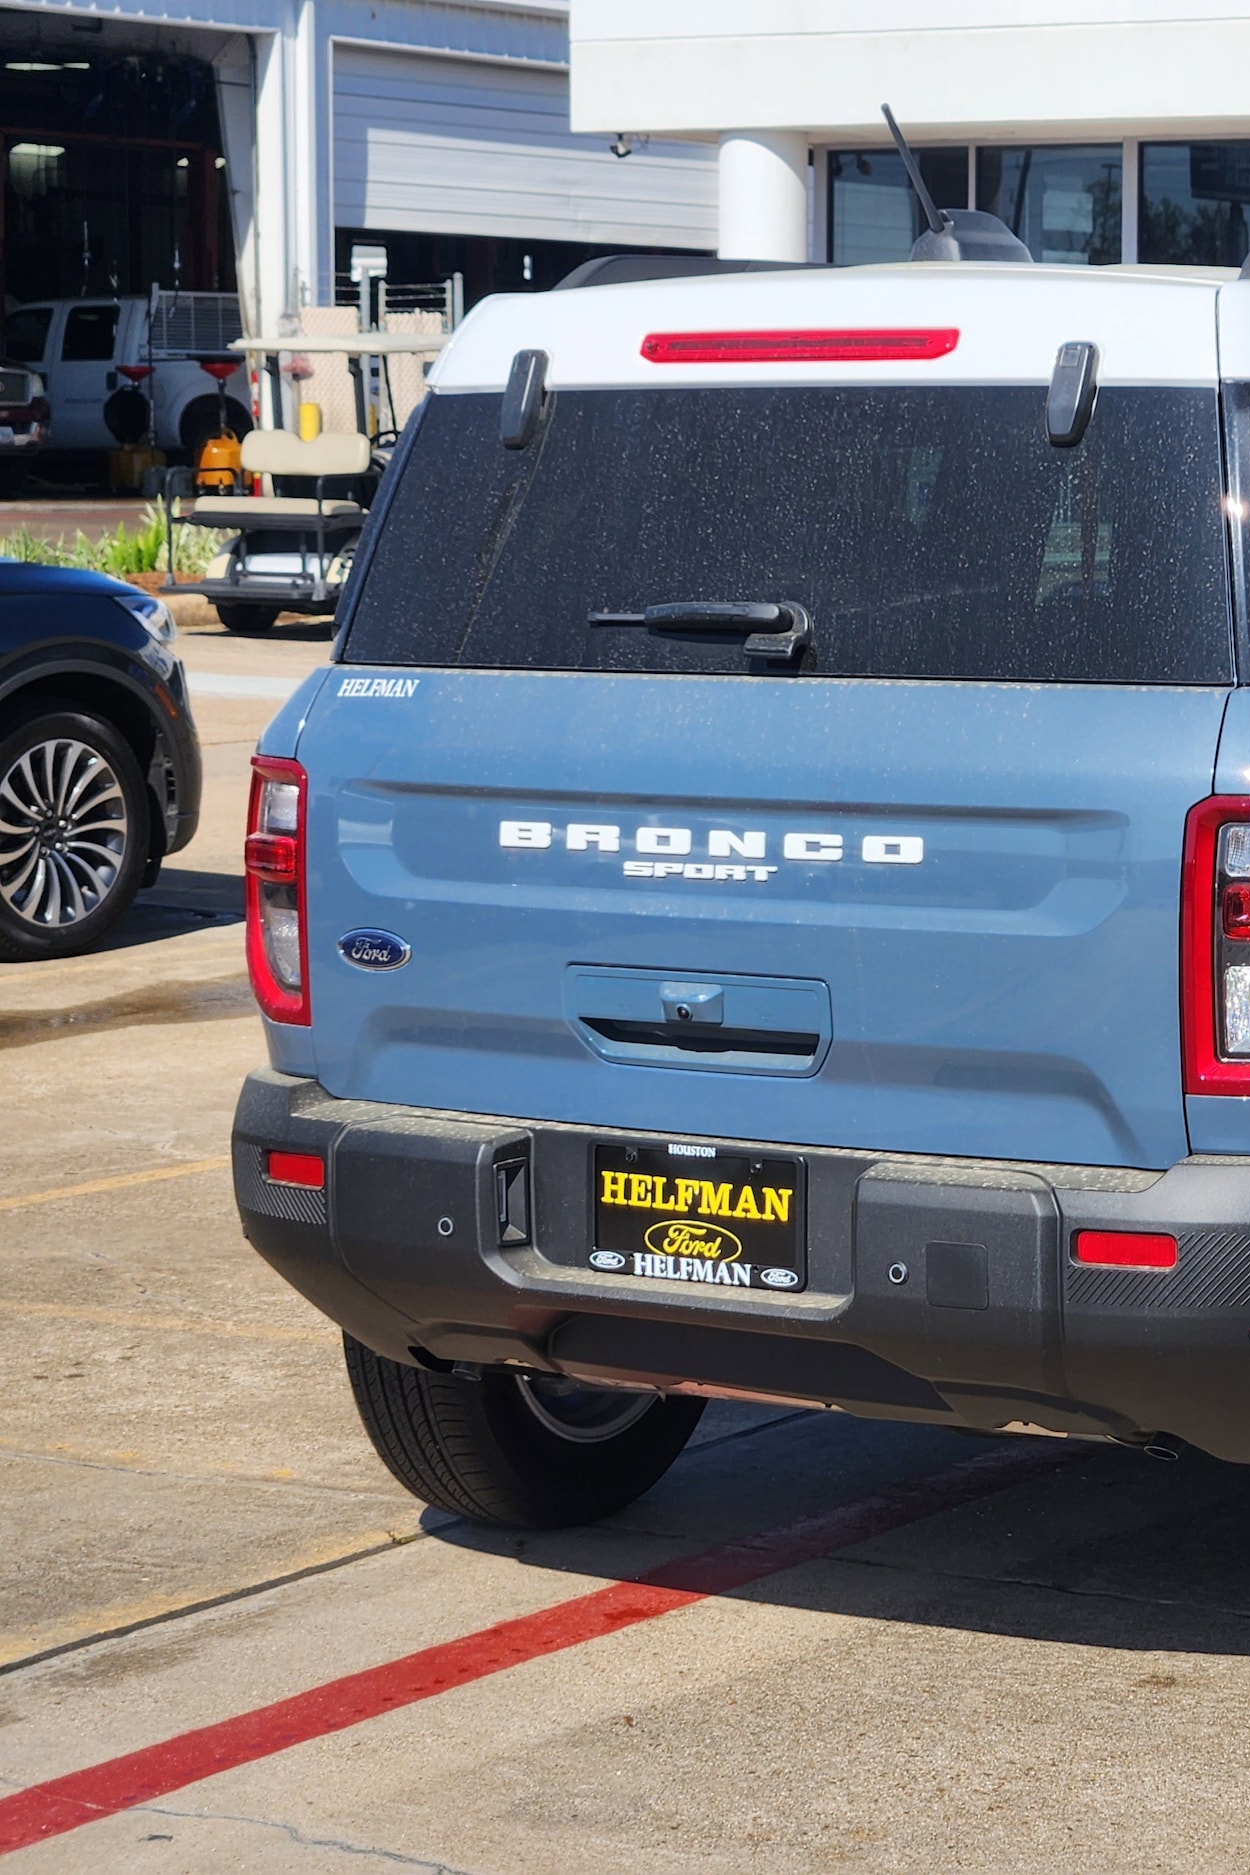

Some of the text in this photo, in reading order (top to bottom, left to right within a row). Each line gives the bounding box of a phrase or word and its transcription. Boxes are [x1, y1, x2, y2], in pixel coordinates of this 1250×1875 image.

[337, 678, 420, 698] HELFMAN
[499, 819, 924, 865] BRONCO
[623, 860, 778, 883] SPORT
[667, 1143, 717, 1158] HOUSTON
[601, 1170, 794, 1223] HELFMAN
[662, 1223, 723, 1259] Ford
[633, 1252, 752, 1287] HELFMAN
